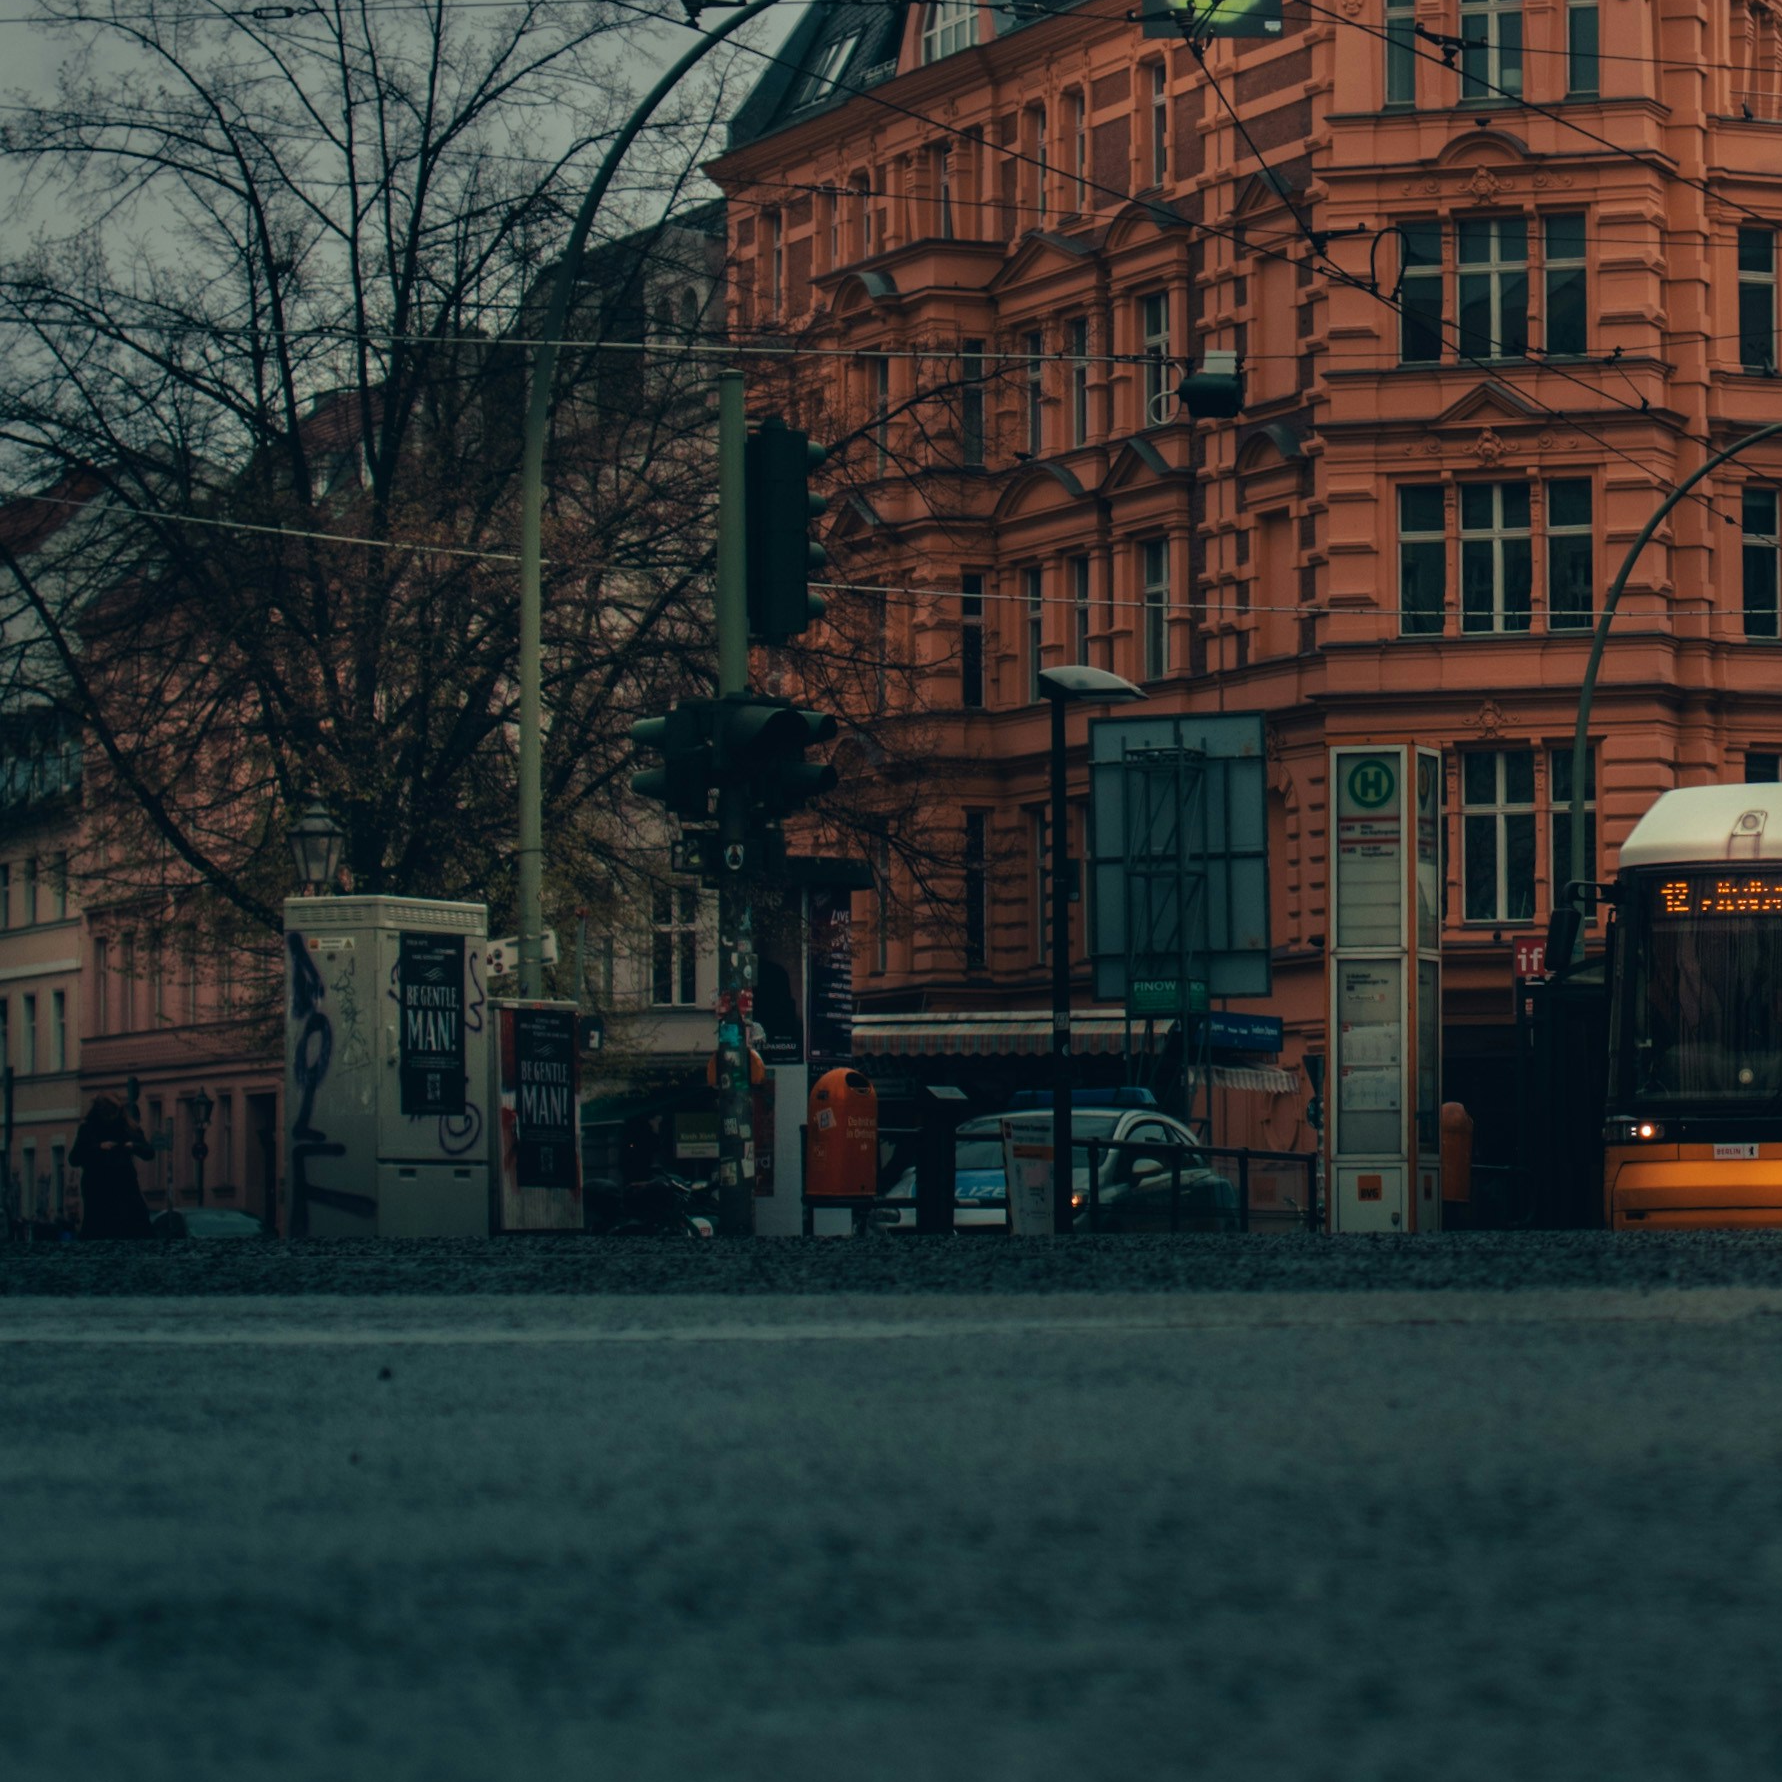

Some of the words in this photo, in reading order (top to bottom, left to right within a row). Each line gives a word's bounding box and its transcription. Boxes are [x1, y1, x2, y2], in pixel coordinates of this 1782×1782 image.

[1361, 771, 1382, 797] H
[406, 984, 419, 1007] BE
[420, 985, 460, 1010] GENTLE,
[1134, 981, 1176, 991] FINOW
[407, 1009, 457, 1052] MAN!
[521, 1060, 534, 1081] BE
[534, 1061, 570, 1085] GENTLE,
[522, 1084, 569, 1126] MAN!
[1360, 1188, 1379, 1198] BVG
